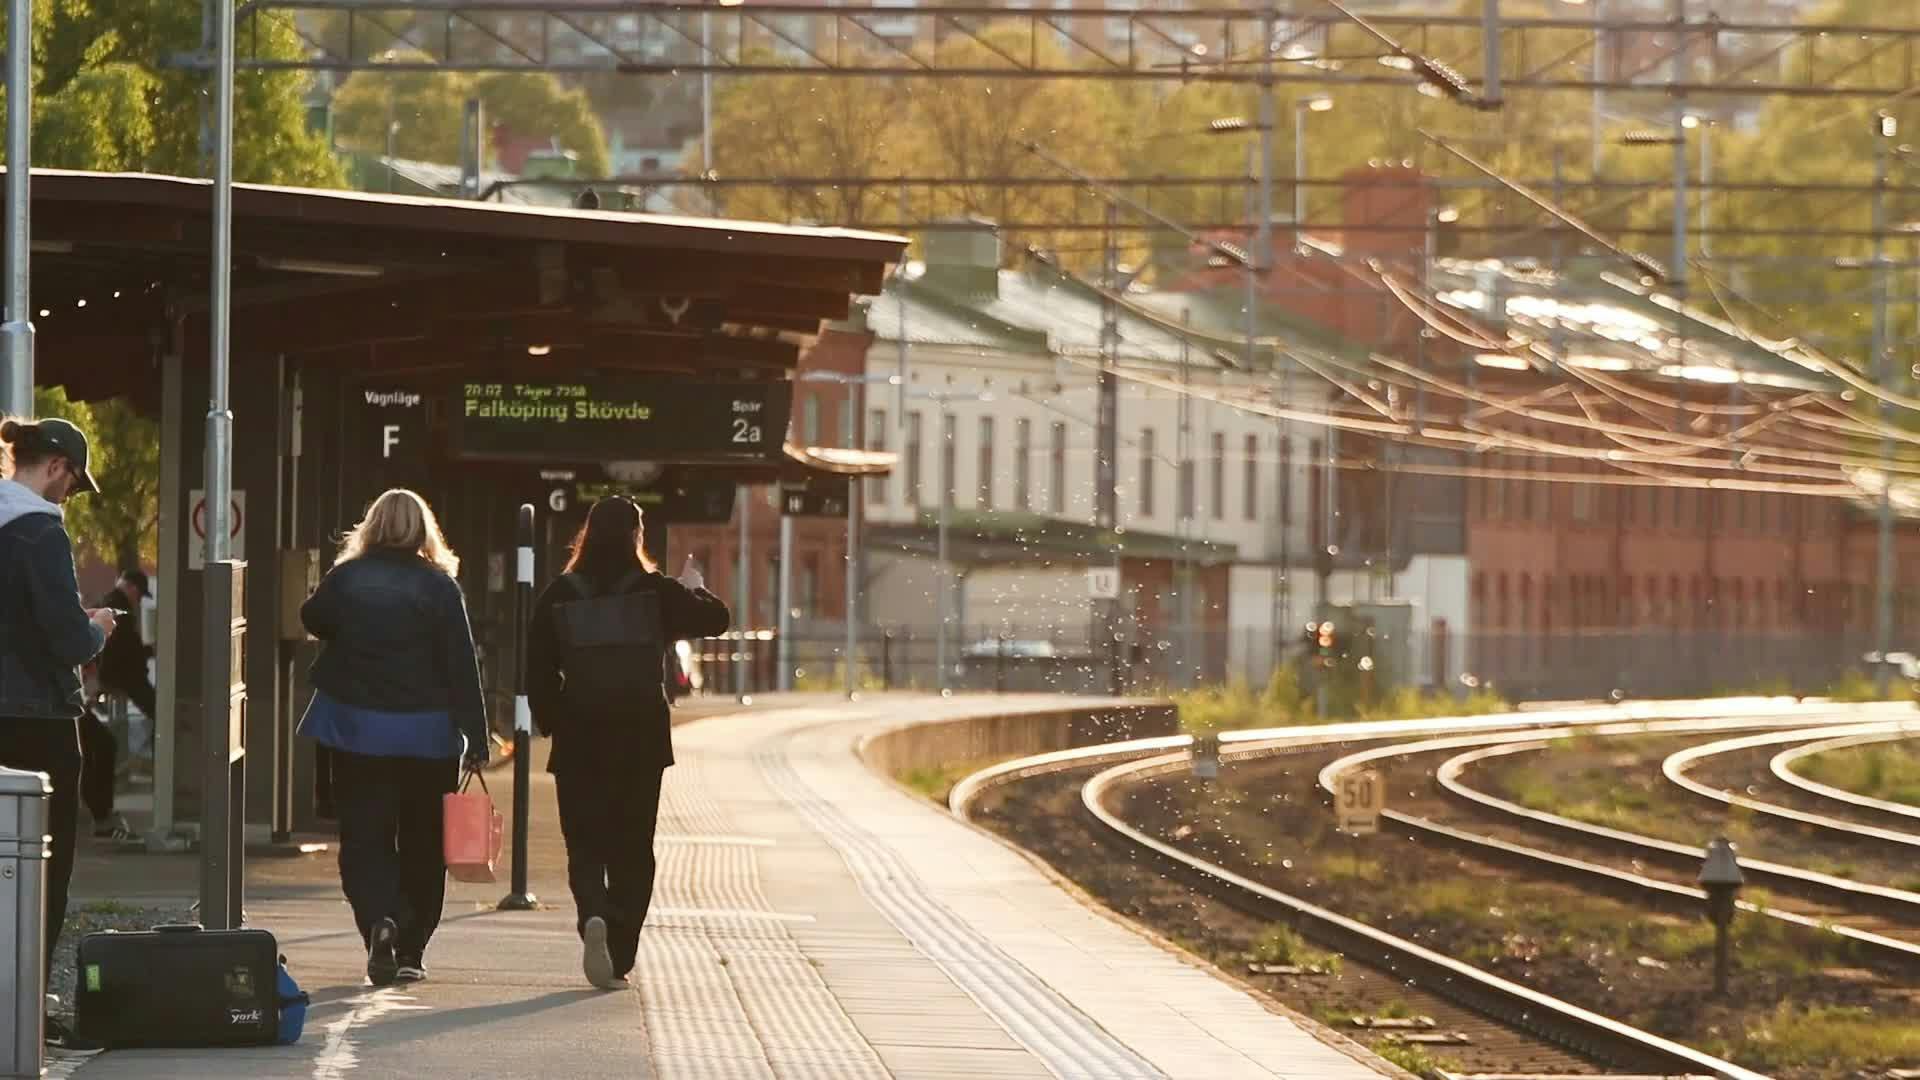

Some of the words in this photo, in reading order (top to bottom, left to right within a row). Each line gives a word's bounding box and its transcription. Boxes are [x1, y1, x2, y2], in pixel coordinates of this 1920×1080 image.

[364, 391, 420, 407] Vagnläge
[464, 400, 568, 422] Falköping
[575, 402, 649, 419] Skövde
[383, 425, 400, 458] F
[732, 419, 760, 442] 2a
[549, 489, 566, 511] G
[1343, 780, 1372, 808] 50
[232, 1010, 259, 1024] york
